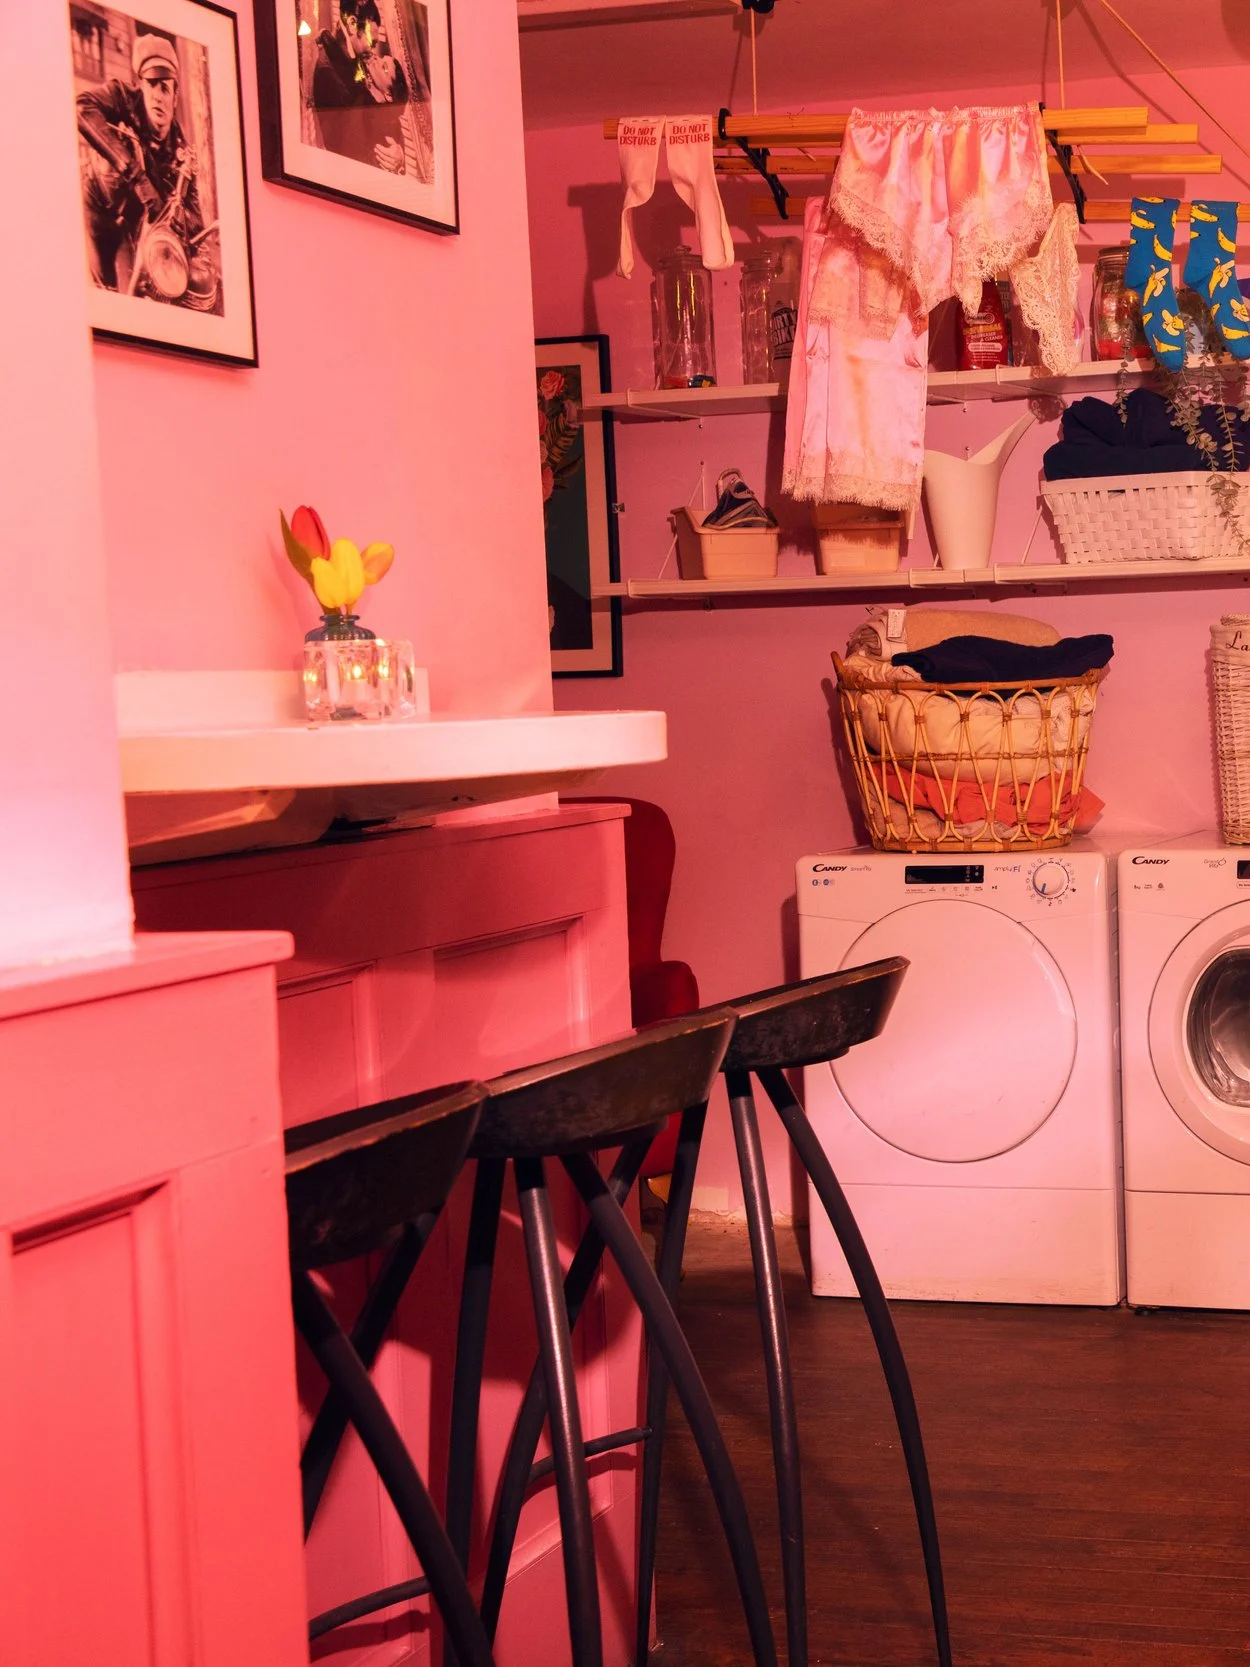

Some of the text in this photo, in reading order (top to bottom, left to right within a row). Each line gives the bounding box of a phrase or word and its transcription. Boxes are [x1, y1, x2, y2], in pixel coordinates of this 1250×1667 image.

[623, 125, 656, 136] DO NOT
[672, 123, 708, 135] DO NOT
[619, 135, 657, 146] DISTURB
[669, 133, 710, 145] DISTURB
